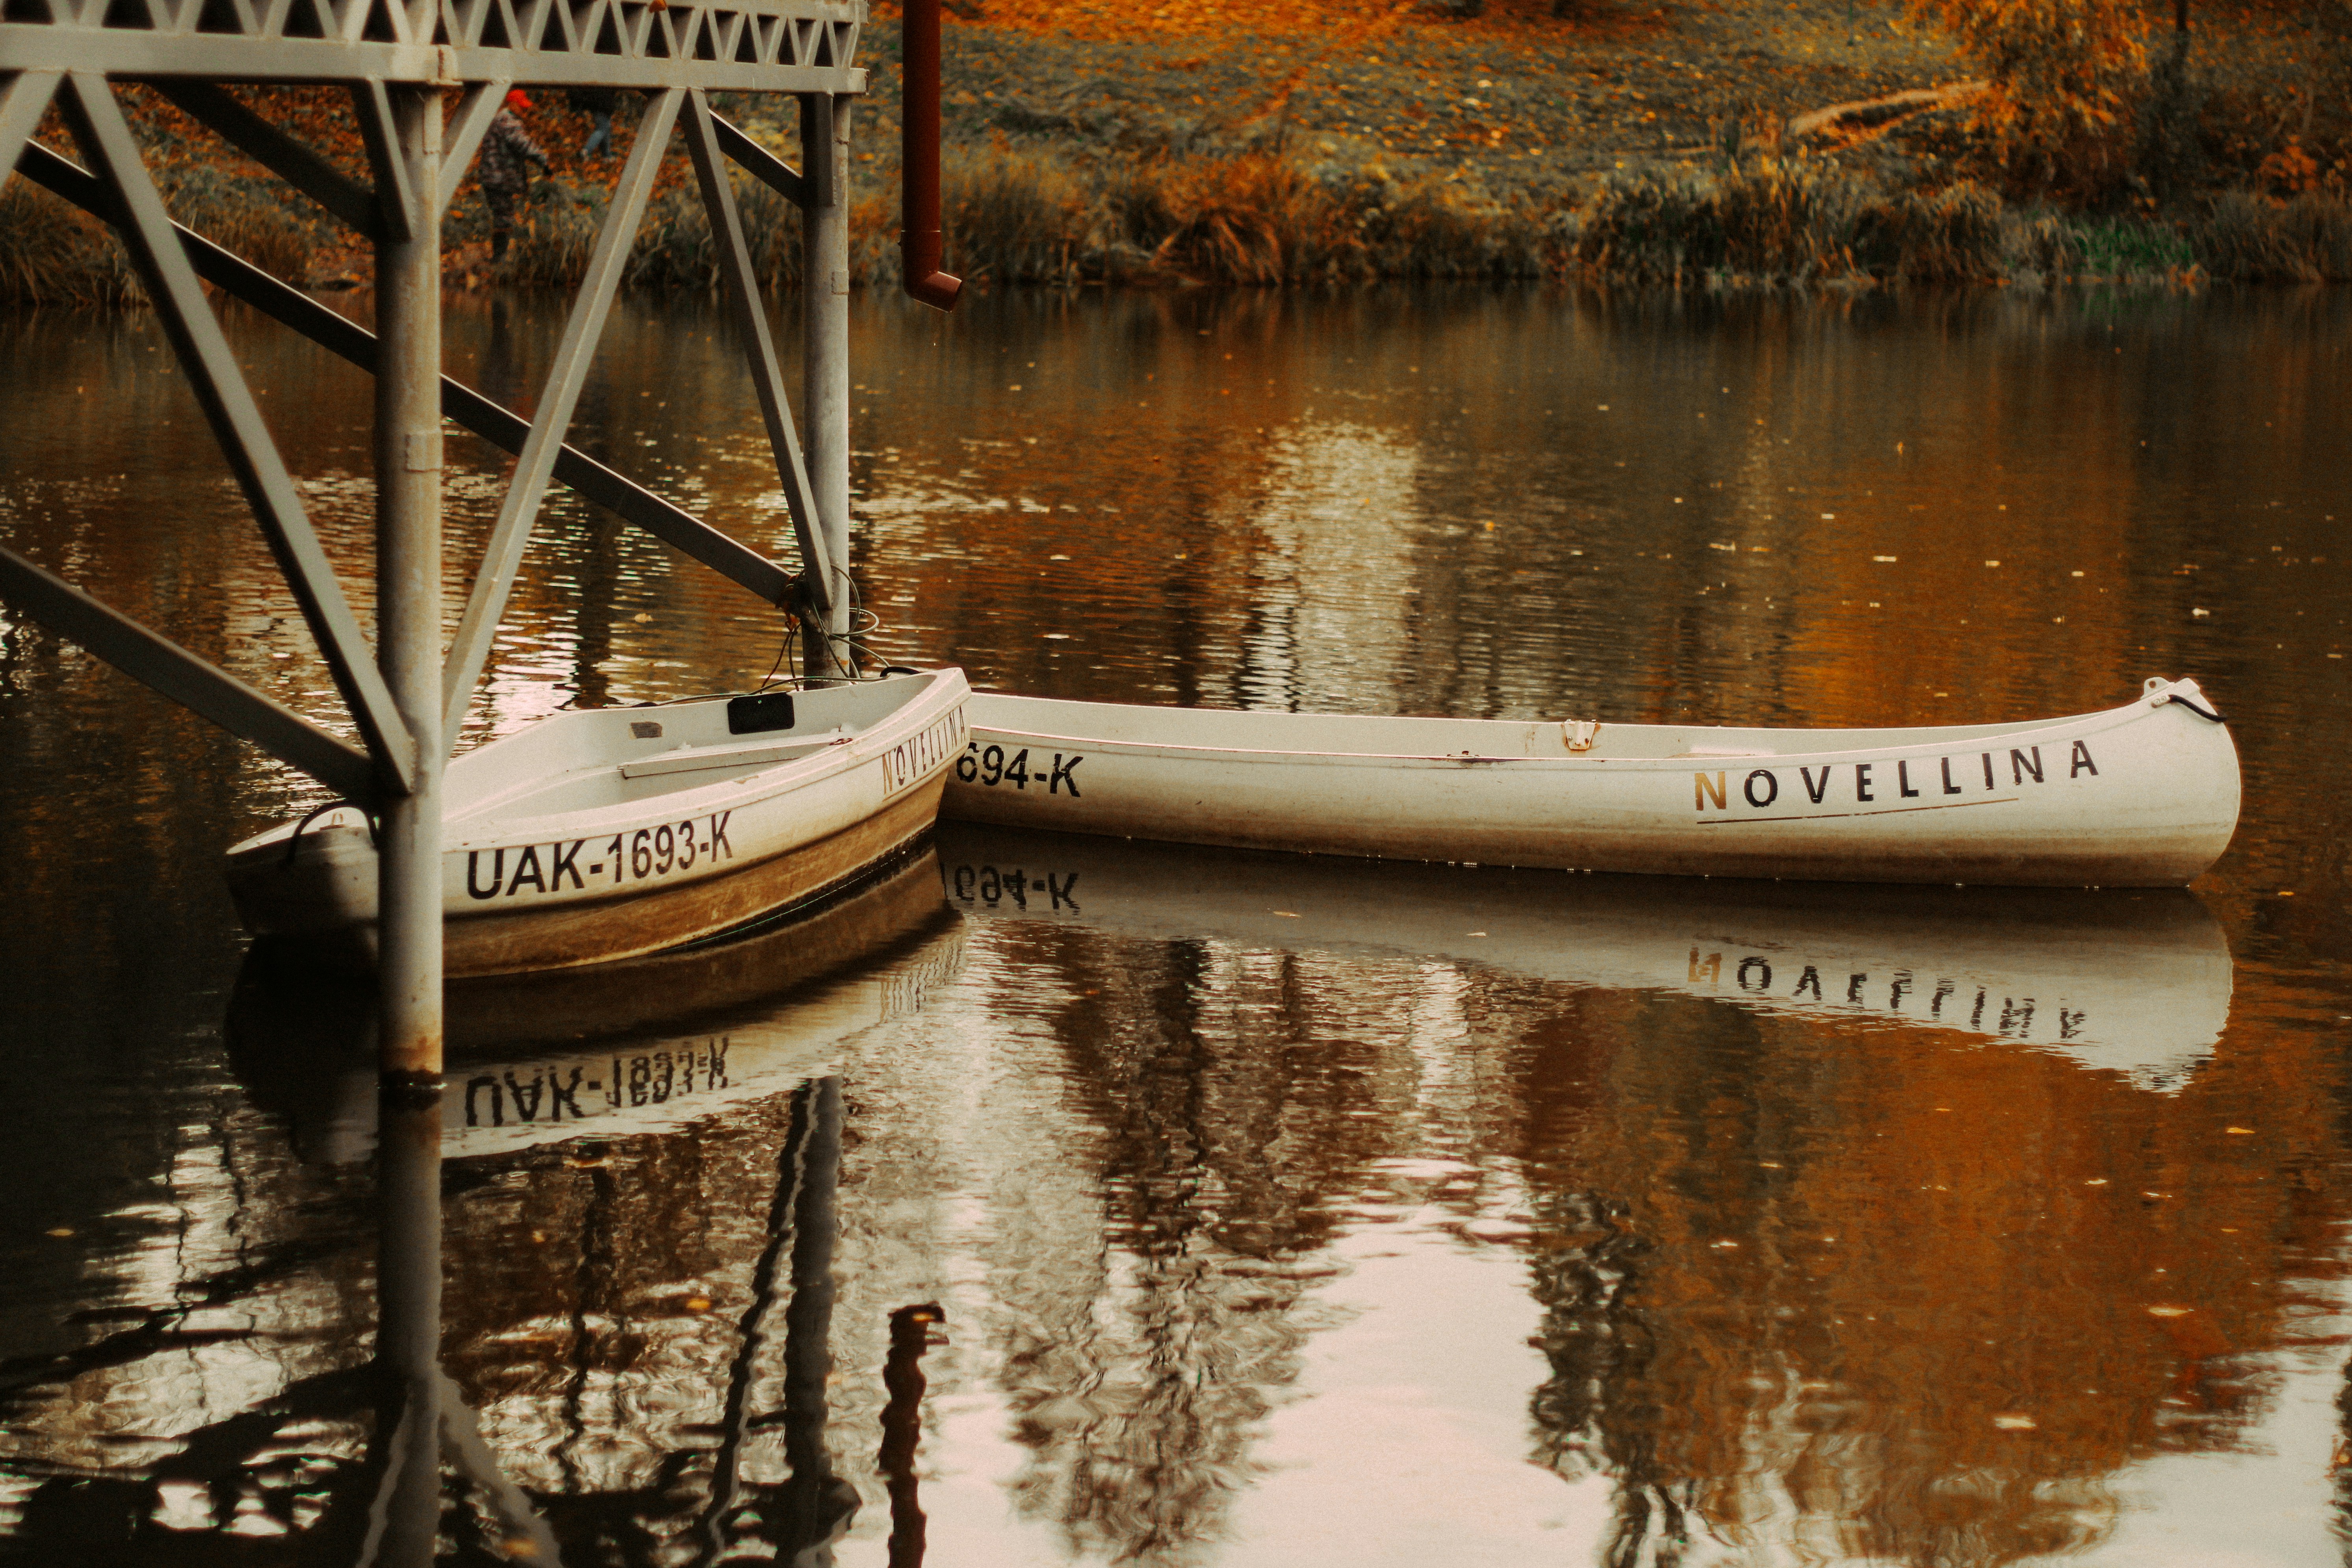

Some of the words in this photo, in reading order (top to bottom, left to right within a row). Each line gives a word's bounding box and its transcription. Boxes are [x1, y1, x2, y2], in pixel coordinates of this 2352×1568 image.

[882, 705, 965, 794] NOVELLINA
[1694, 740, 2098, 811] NOVELLINA
[467, 811, 733, 900] UAK-1693-K
